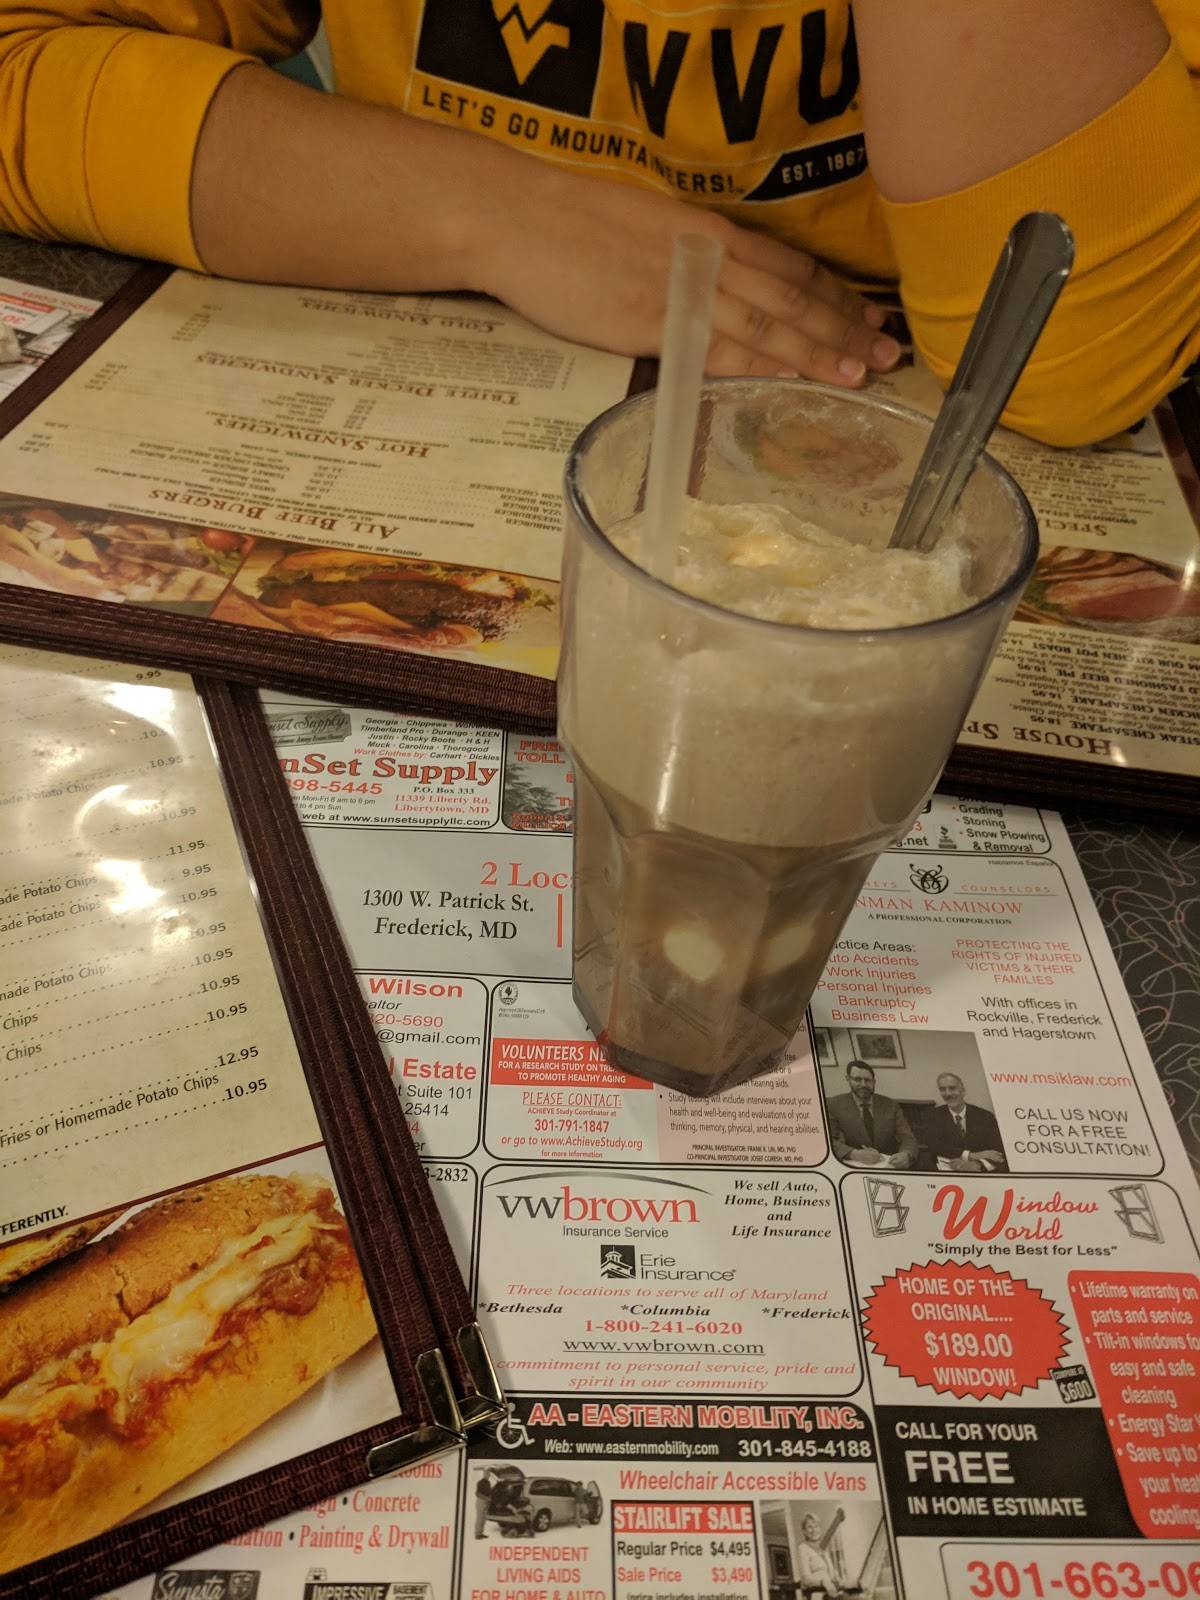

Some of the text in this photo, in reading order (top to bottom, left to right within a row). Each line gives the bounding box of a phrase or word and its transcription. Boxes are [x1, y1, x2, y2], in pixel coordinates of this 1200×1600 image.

[423, 85, 495, 128] LET'S
[508, 113, 539, 142] GO
[782, 148, 865, 184] EST. 1867
[194, 354, 520, 406] TRIPLE DECKER SANDWICHES
[215, 416, 430, 459] HOT SANDWICHES
[149, 488, 400, 540] ALL BEEF BURGERS
[136, 670, 162, 680] 9.95
[360, 725, 406, 734] Timberland
[431, 729, 468, 737] Durango
[475, 730, 500, 738] KEEN
[963, 721, 1111, 755] HOUSE SP
[1070, 720, 1155, 739] CHESAPEAKE
[514, 752, 565, 764] TOLL
[280, 753, 499, 786] nSet Supply
[413, 786, 433, 794] P.O.
[395, 804, 490, 815] Libertytown, MD
[959, 804, 1004, 817] Grading
[302, 813, 326, 821] web
[343, 814, 491, 826] www.sunsetsupplyllc.com
[962, 817, 1006, 829] Stoning
[967, 828, 1047, 843] Snow Plowing
[169, 840, 206, 856] 11.95
[972, 841, 1034, 853] & Removal
[182, 864, 212, 877] 9.95
[363, 889, 535, 913] 1300 W. Patrick St.
[924, 899, 1023, 914] KAMINOW
[27, 910, 65, 926] Potato
[876, 914, 945, 924] PROFESSIONAL
[946, 916, 1012, 925] CORPORATION
[374, 917, 517, 941] Frederick, MD
[195, 948, 234, 966] 10.95
[826, 966, 917, 981] Work Injuries
[994, 974, 1055, 986] FAMILIES
[201, 974, 241, 993] 10.95
[369, 978, 463, 998] Wilson
[839, 995, 917, 1010] Bankruptcy
[3, 1012, 39, 1031] Chips
[208, 1003, 248, 1022] 10.95
[832, 1010, 929, 1024] Business Law
[5, 1043, 42, 1062] Chips
[218, 1046, 259, 1068] 12.95
[502, 1044, 584, 1062] VOLUNTEERS
[403, 1058, 477, 1080] Estate
[990, 1072, 1132, 1088] www.msiklaw.com
[225, 1078, 267, 1101] 10.95
[407, 1085, 473, 1099] Suite 101
[522, 1091, 622, 1108] PLEASE CONTACT:
[0, 1074, 220, 1149] Fries or Homemade Potato Chips
[405, 1103, 449, 1116] 25414
[534, 1119, 609, 1133] 301-791-1847
[670, 1122, 698, 1133] thinking,
[699, 1125, 726, 1133] memory,
[728, 1125, 753, 1135] physical,
[770, 1126, 794, 1136] hearing
[501, 1136, 643, 1150] or go to www.AchieveStudy.org
[1014, 1141, 1151, 1157] CONSULTATION!
[496, 1185, 700, 1223] vwbrown
[562, 1225, 669, 1239] Insurance Service
[640, 1253, 676, 1268] Erie
[640, 1267, 732, 1282] Insurance
[899, 1277, 1015, 1297] HOME OF THE
[1080, 1282, 1198, 1303] Lifetime warranty on
[583, 1320, 743, 1335] 1-800-241-6020
[562, 1339, 765, 1354] www.vwbrown.com
[925, 1331, 1013, 1358] $189.00
[934, 1367, 1017, 1387] WINDOW!
[1059, 1379, 1093, 1402] $600
[1122, 1386, 1178, 1409] cleaning
[527, 1403, 864, 1433] AA EASTERN MOBILITY, INC.
[896, 1422, 1037, 1441] CALL FOR YOUR
[544, 1439, 872, 1458] Web: www.easternmobility.com 301-845-4188
[905, 1450, 1015, 1484] FREE
[619, 1470, 867, 1492] Wheelchair Accessible Vans
[352, 1490, 421, 1512] Concrete
[907, 1496, 1087, 1516] IN HOME ESTIMATE
[614, 1506, 753, 1530] STAIRLIFT SALE
[298, 1526, 450, 1554] Painting & Drywall
[489, 1546, 589, 1562] INDEPENDENT
[617, 1541, 751, 1558] Regular Price $4,495
[497, 1569, 581, 1584] LIVING AIDS
[617, 1567, 753, 1583] Sale Price $3,490
